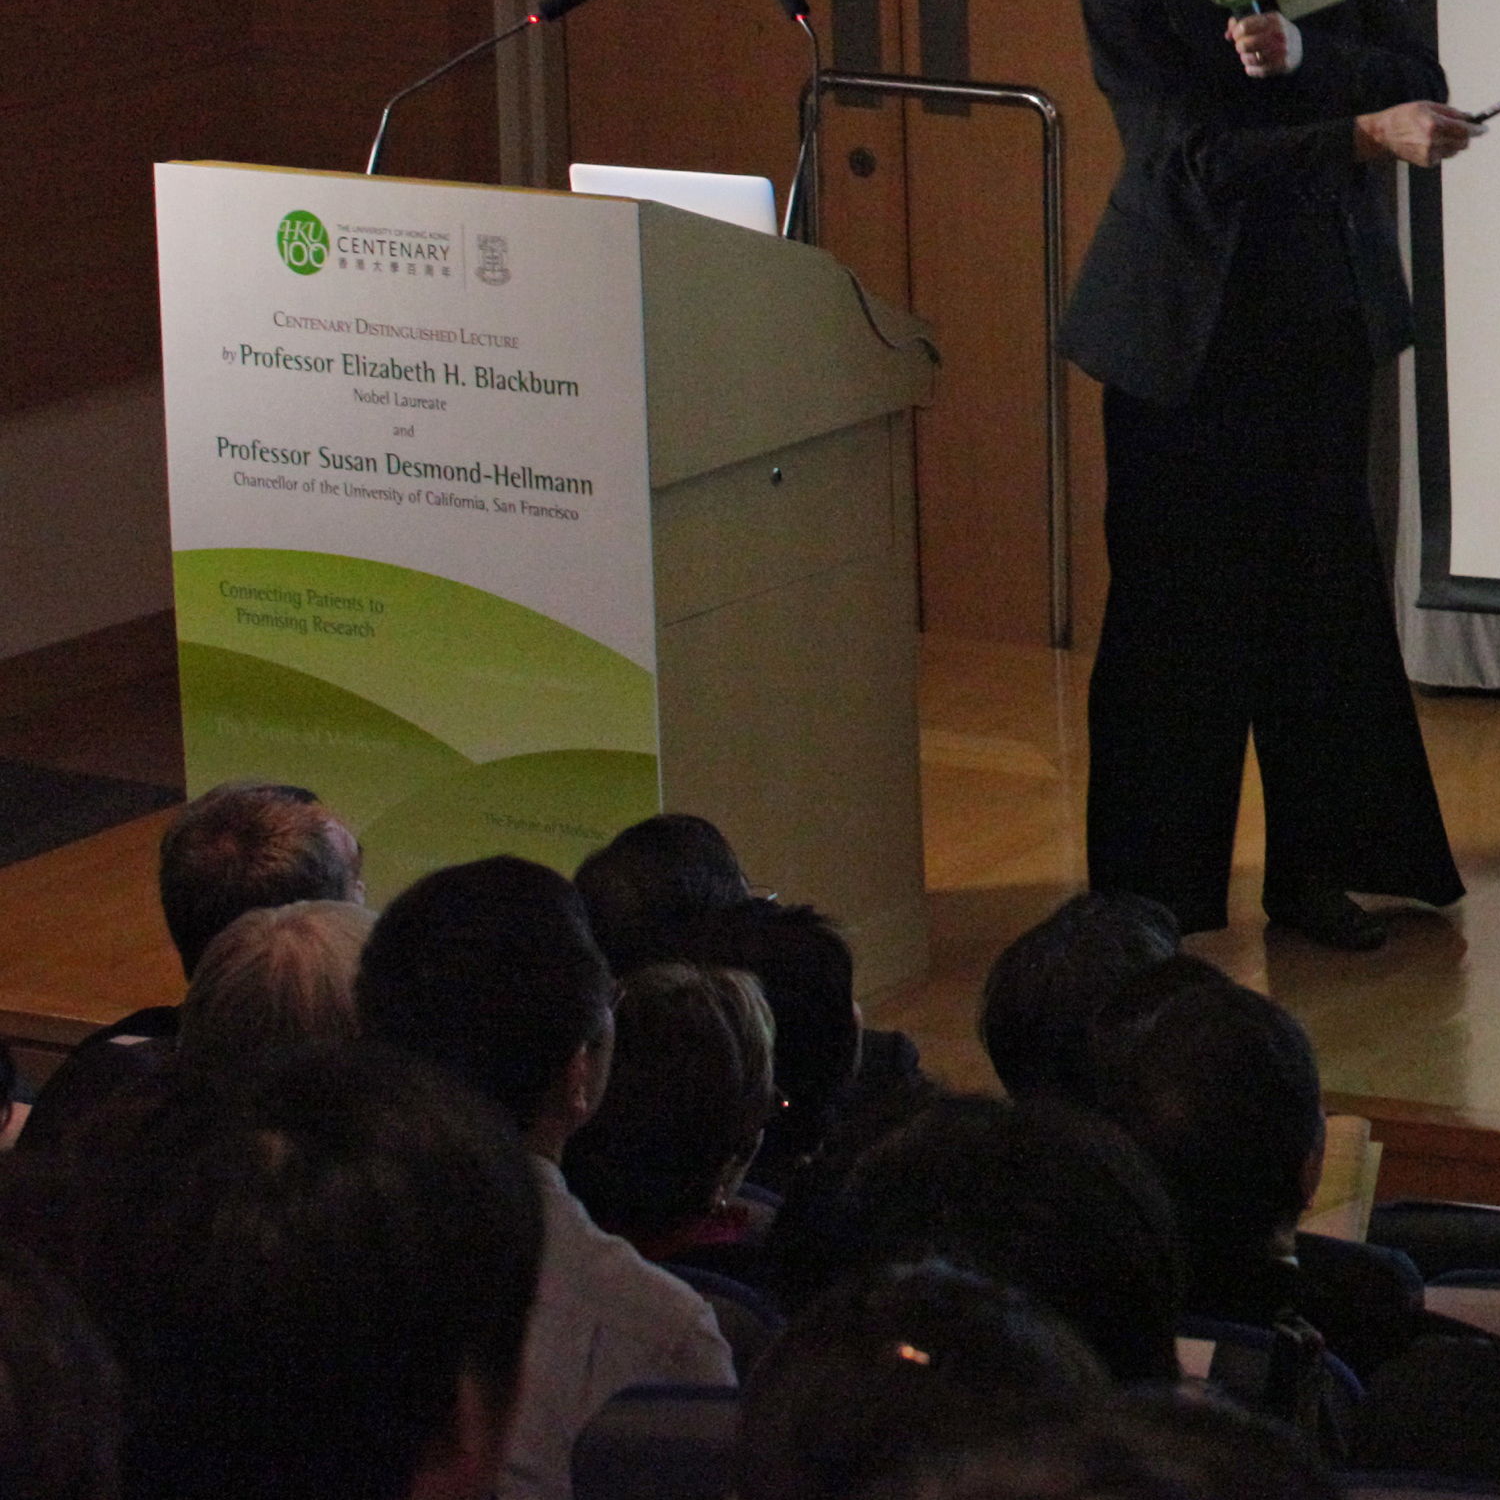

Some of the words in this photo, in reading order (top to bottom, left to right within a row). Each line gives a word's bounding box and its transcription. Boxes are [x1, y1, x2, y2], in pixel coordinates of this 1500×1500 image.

[279, 218, 323, 244] HKU
[284, 240, 328, 268] 100
[337, 236, 450, 261] CENTENARY
[273, 311, 351, 333] CENTENARY
[355, 318, 456, 343] DISTINGUISHED
[460, 328, 519, 349] LECTURE
[222, 347, 236, 364] by
[240, 344, 335, 373] Professor
[342, 353, 435, 383] Elizabeth
[444, 363, 466, 386] H.
[475, 366, 579, 397] Blackburn
[353, 388, 390, 405] Nobel
[395, 393, 447, 410] Laureate
[393, 425, 414, 437] and
[217, 436, 311, 466] Professor
[319, 446, 377, 473] Susan
[386, 453, 593, 495] Desmond-Hellmann
[234, 471, 298, 491] Chancellor
[303, 479, 315, 492] of
[320, 481, 340, 496] the
[344, 484, 403, 505] University
[408, 490, 422, 504] of
[426, 491, 489, 512] California,
[494, 498, 516, 512] San
[521, 501, 579, 520] Francisco
[219, 580, 302, 609] Connecting
[306, 589, 363, 612] Patients
[369, 599, 384, 613] to
[236, 607, 307, 634] Promising
[312, 615, 376, 638] Research
